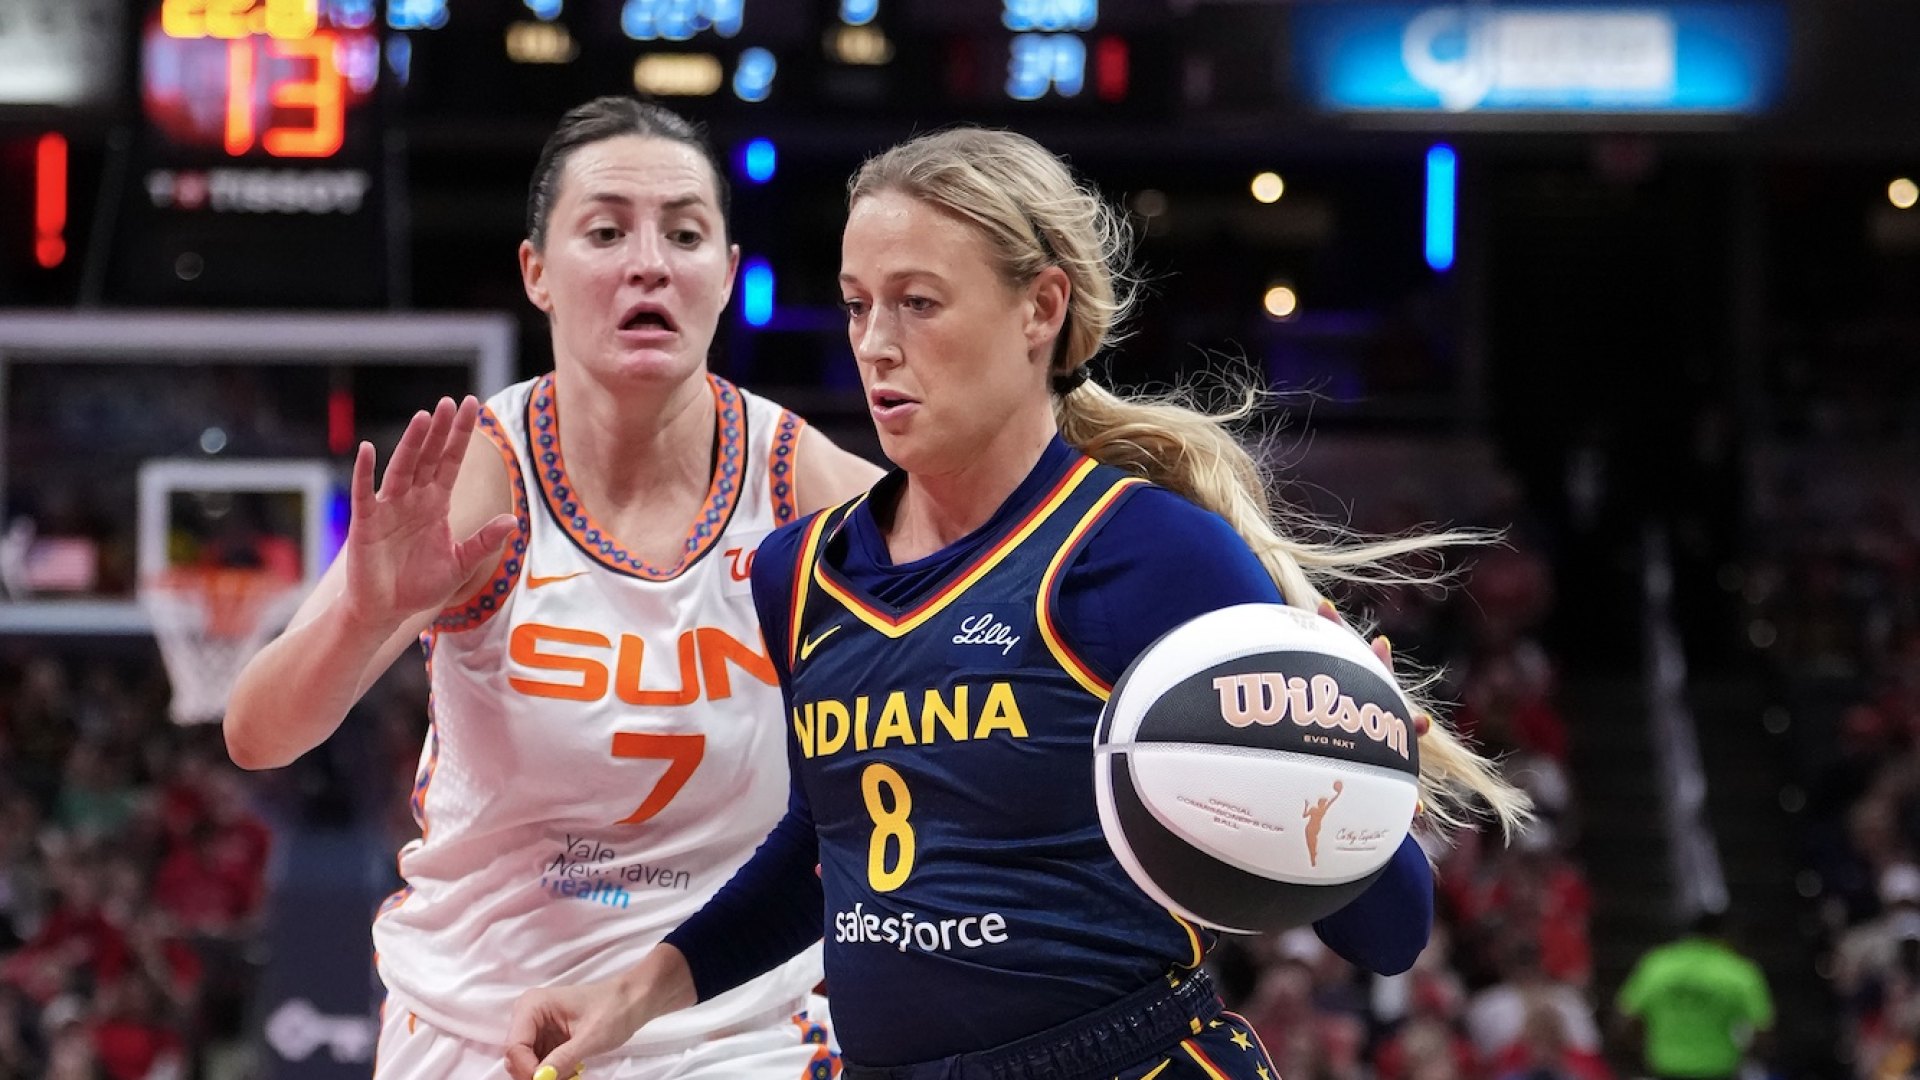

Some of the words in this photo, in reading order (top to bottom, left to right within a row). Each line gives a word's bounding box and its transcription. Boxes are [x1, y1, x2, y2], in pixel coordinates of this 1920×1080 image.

[224, 28, 345, 158] 13
[508, 623, 780, 707] SUN
[952, 613, 1021, 655] Lilly
[793, 682, 1030, 759] NDIANA
[1213, 672, 1410, 761] Wilson
[1304, 734, 1329, 745] EVO
[1332, 740, 1356, 750] NXT
[611, 732, 706, 826] 7
[565, 833, 615, 863] Yale
[861, 762, 916, 893] 8
[835, 902, 1009, 952] salesforce
